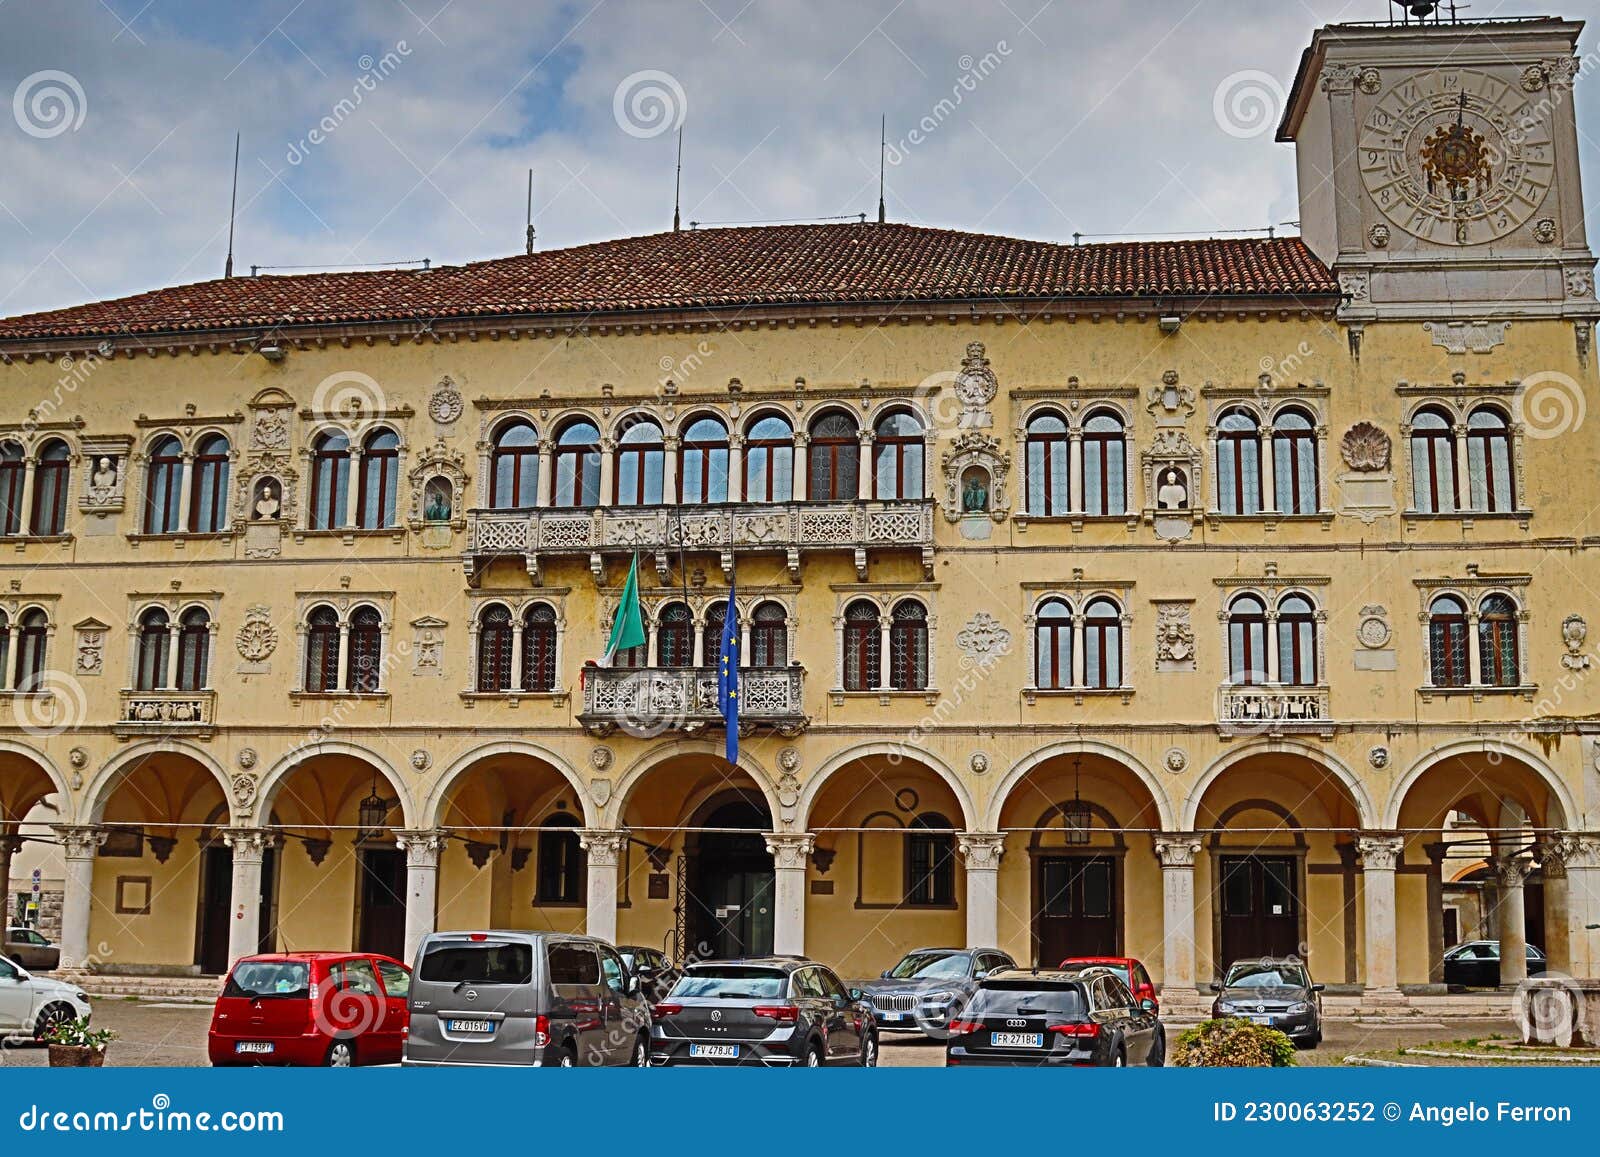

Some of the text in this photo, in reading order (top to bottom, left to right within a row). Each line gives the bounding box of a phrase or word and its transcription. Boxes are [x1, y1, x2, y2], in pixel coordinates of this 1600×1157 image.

[1443, 75, 1458, 88] 12
[1373, 113, 1388, 127] 10
[1368, 151, 1378, 165] 9
[1380, 190, 1390, 204] 8
[453, 1021, 462, 1030] EZ
[998, 1034, 1008, 1044] FR
[696, 1046, 706, 1054] FV
